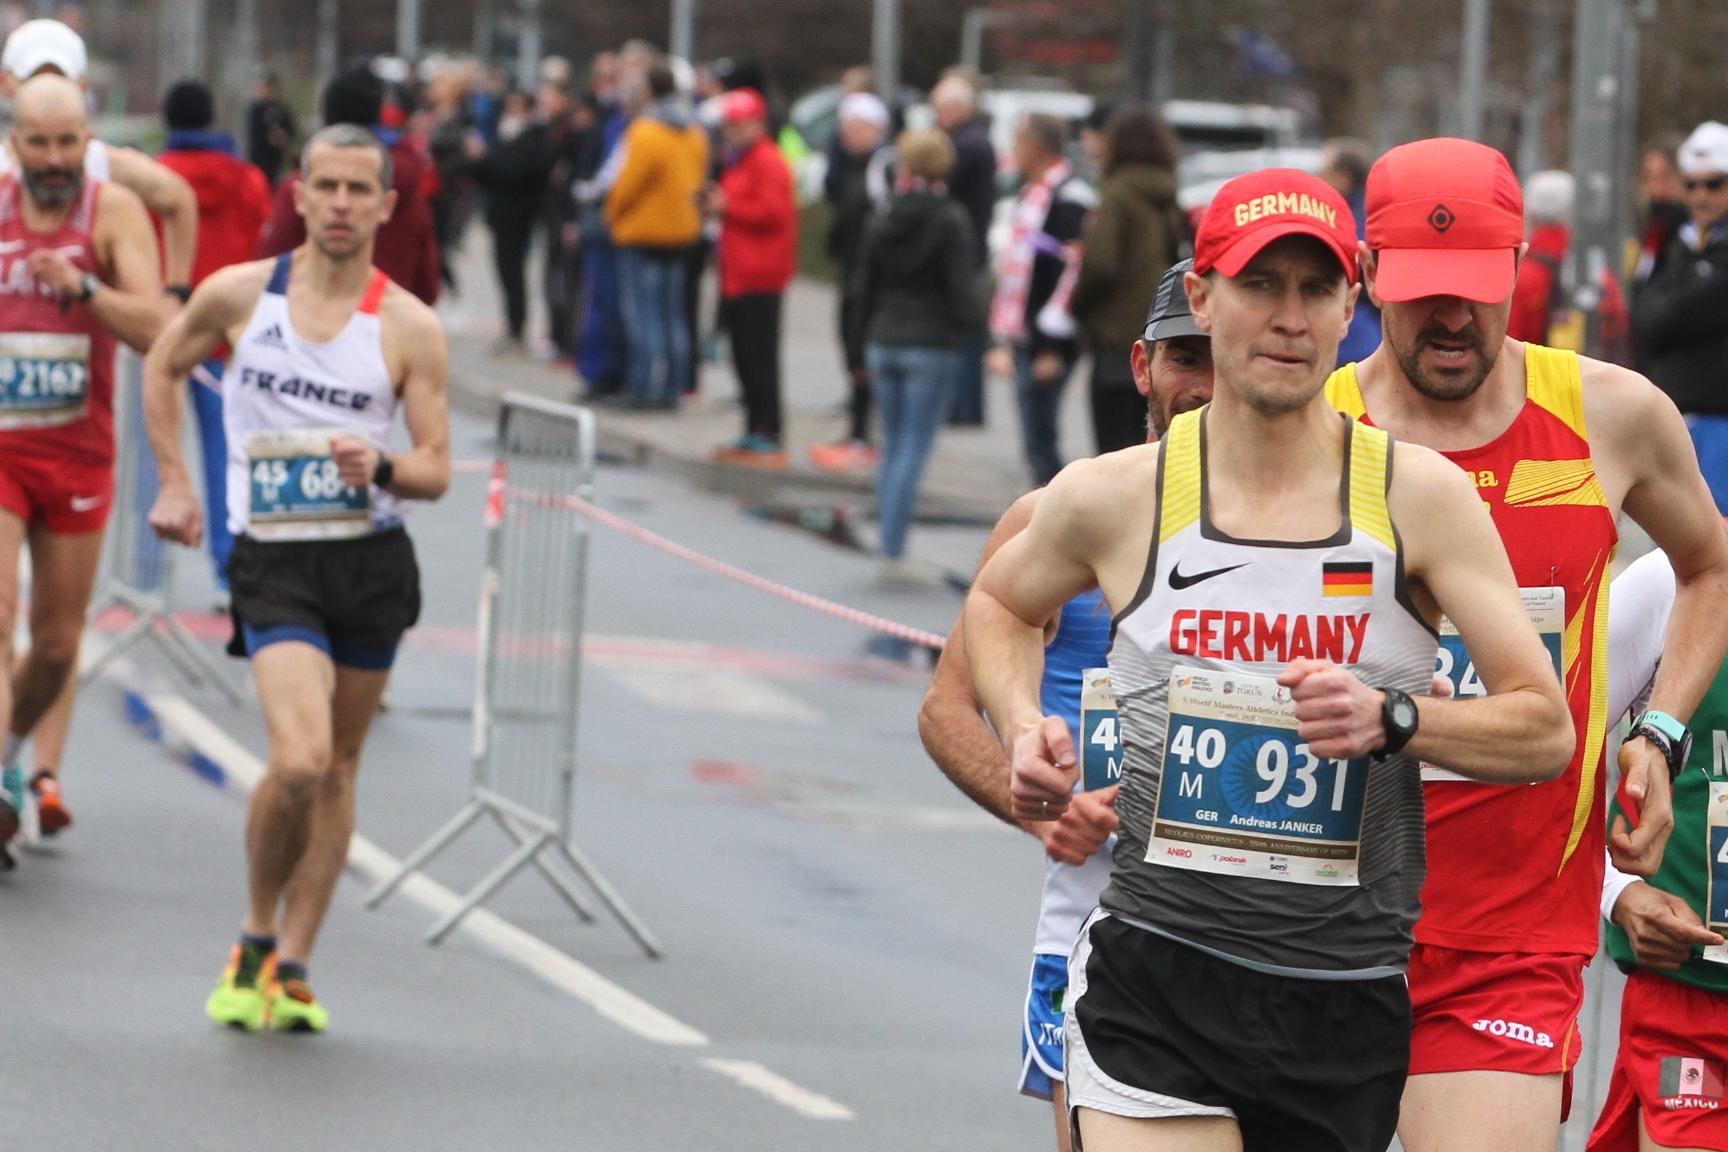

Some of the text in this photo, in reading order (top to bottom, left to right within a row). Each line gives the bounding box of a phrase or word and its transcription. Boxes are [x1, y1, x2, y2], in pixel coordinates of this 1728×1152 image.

[1234, 191, 1338, 229] GERMANY
[241, 368, 372, 411] FRANCE
[300, 459, 358, 500] 68
[1169, 609, 1372, 664] GERMANY
[1214, 701, 1244, 711] Masters
[1246, 705, 1279, 716] Athletics
[1091, 717, 1123, 751] 4
[1170, 724, 1349, 812] 40 931
[1178, 771, 1203, 799] M
[1195, 809, 1323, 835] GER Andreas JANKER
[1167, 847, 1193, 858] ANIRO
